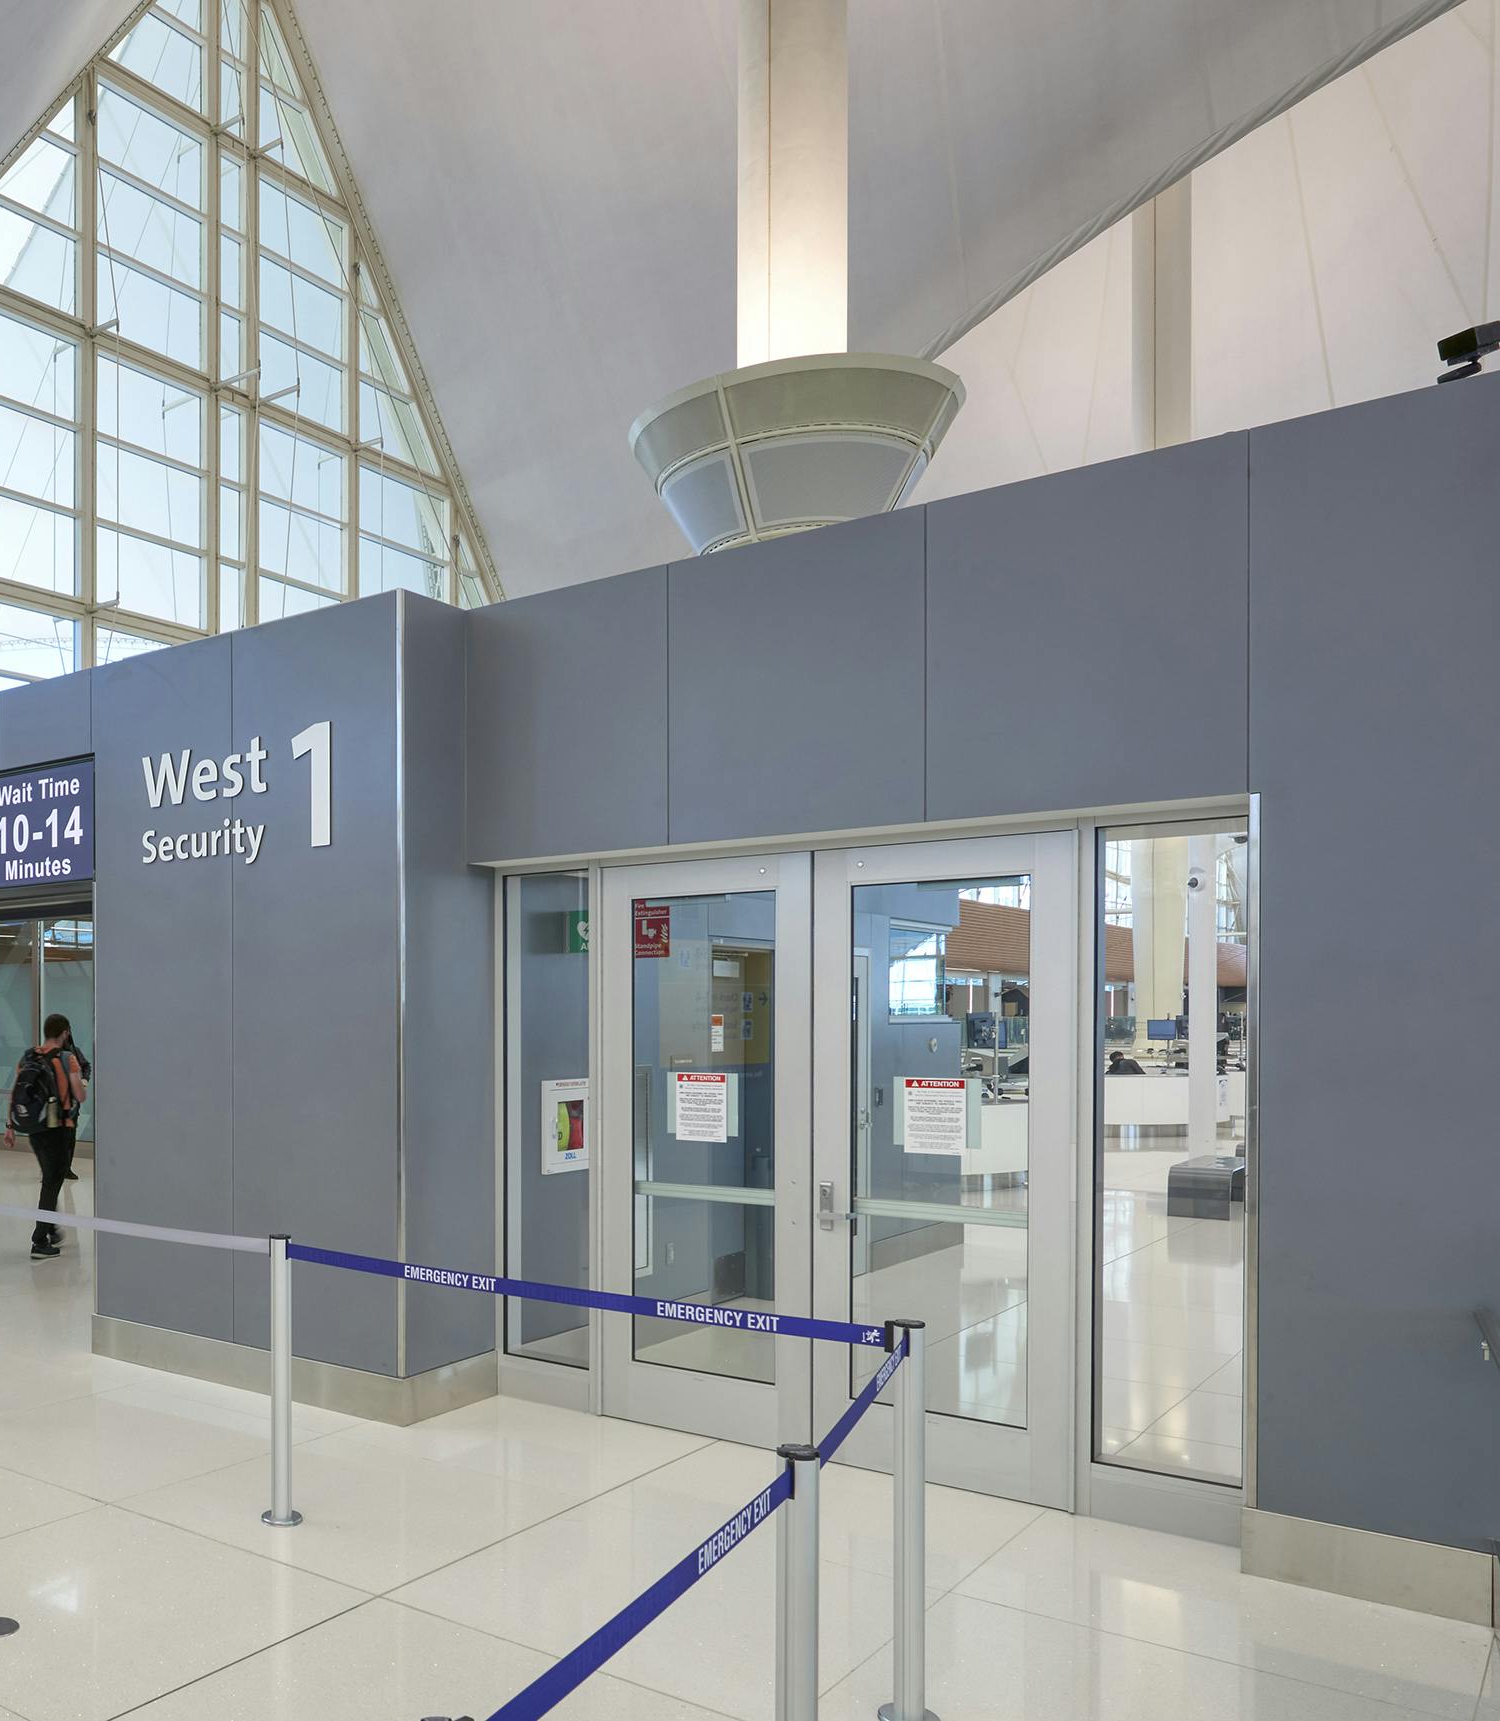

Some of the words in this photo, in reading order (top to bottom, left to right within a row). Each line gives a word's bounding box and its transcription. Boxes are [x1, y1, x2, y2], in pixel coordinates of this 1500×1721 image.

[38, 777, 80, 800] Time
[142, 735, 268, 809] West
[291, 720, 331, 848] 1
[142, 818, 265, 865] Security
[5, 856, 72, 881] Minutes
[920, 1080, 960, 1088] ATTENTION
[404, 1265, 469, 1288] EMERGENCY
[471, 1276, 497, 1292] EXIT
[656, 1301, 743, 1327] EMERGENCY
[747, 1313, 780, 1332] EXIT
[698, 1504, 752, 1575] EMERGENCY
[753, 1488, 771, 1524] EXIT
